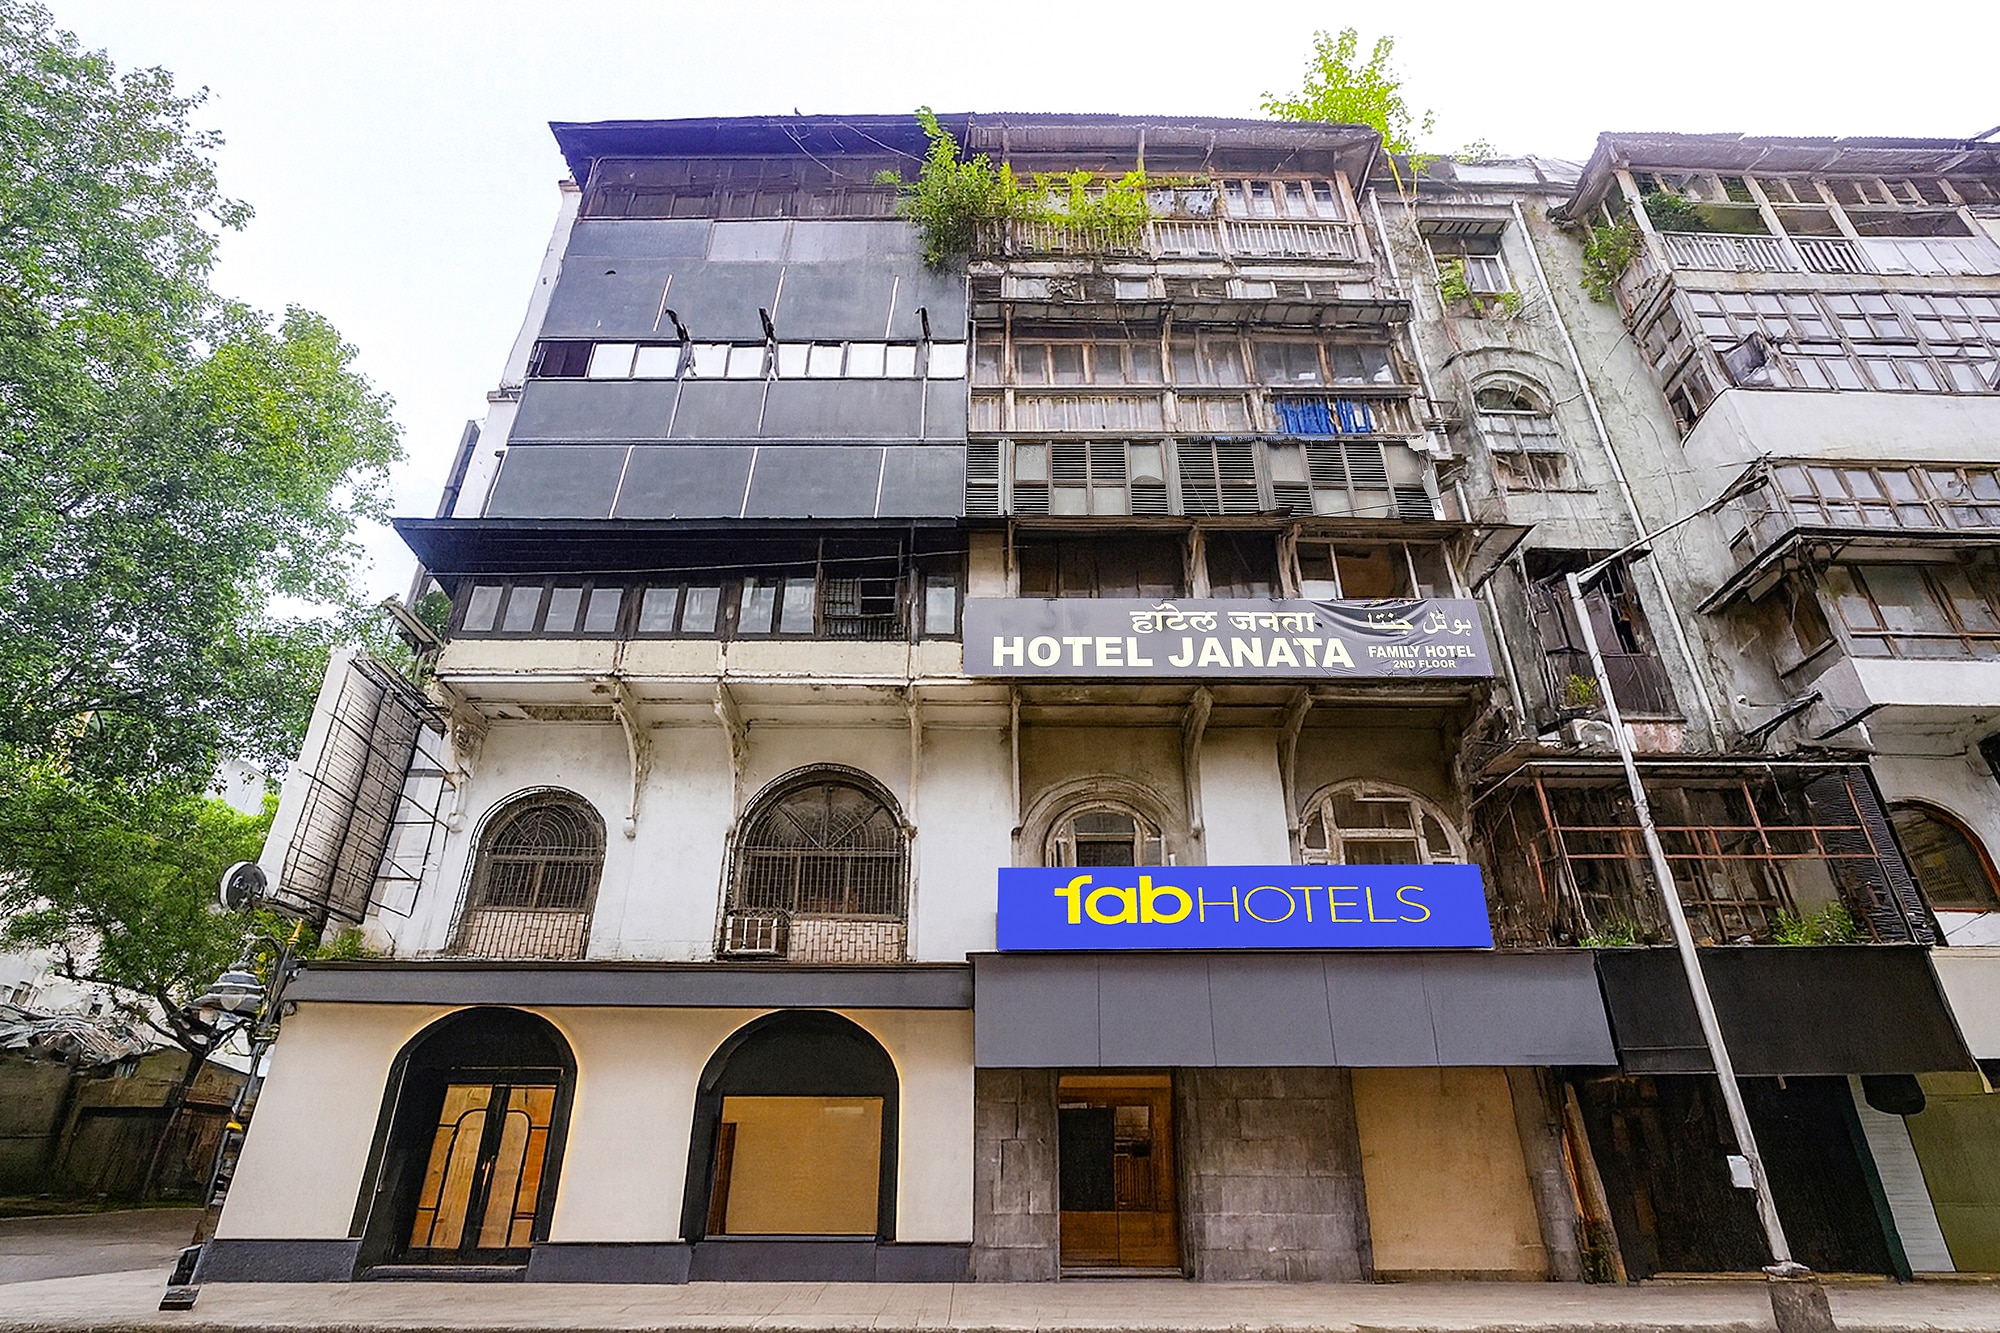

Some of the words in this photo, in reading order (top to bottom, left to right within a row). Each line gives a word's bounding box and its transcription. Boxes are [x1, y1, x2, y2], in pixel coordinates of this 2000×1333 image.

[1129, 602, 1218, 634] हॉटेल
[1227, 611, 1316, 633] जनता
[992, 636, 1153, 667] HOTEL
[1168, 637, 1355, 668] JANATA
[1368, 645, 1420, 658] FAMILY
[1424, 645, 1476, 658] HOTEL
[1393, 659, 1416, 669] 2ND
[1419, 659, 1457, 669] FLOOR
